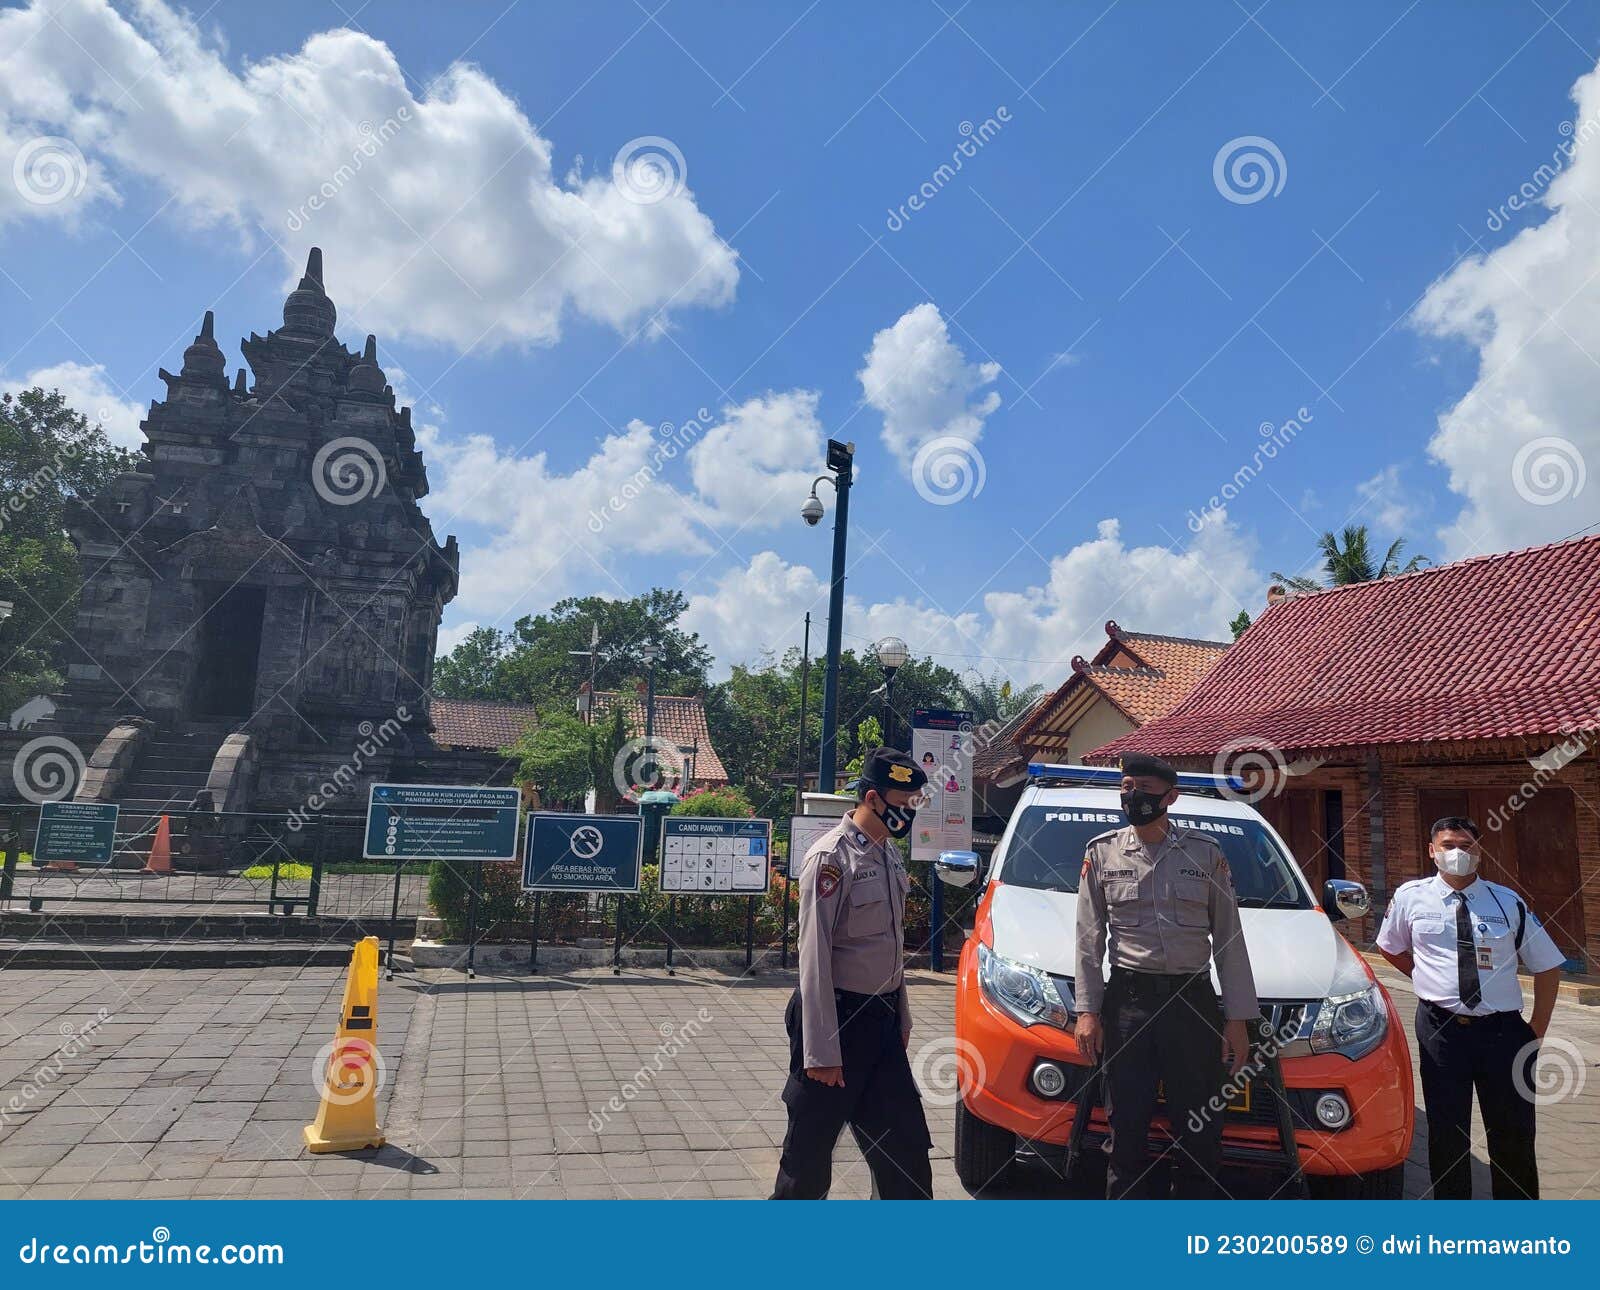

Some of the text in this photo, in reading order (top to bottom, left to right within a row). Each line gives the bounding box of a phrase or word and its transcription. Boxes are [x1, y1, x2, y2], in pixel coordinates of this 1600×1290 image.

[1045, 812, 1121, 824] POLRES
[678, 824, 699, 832] CANDI
[550, 865, 569, 873] AREA
[593, 867, 617, 875] ROKOK
